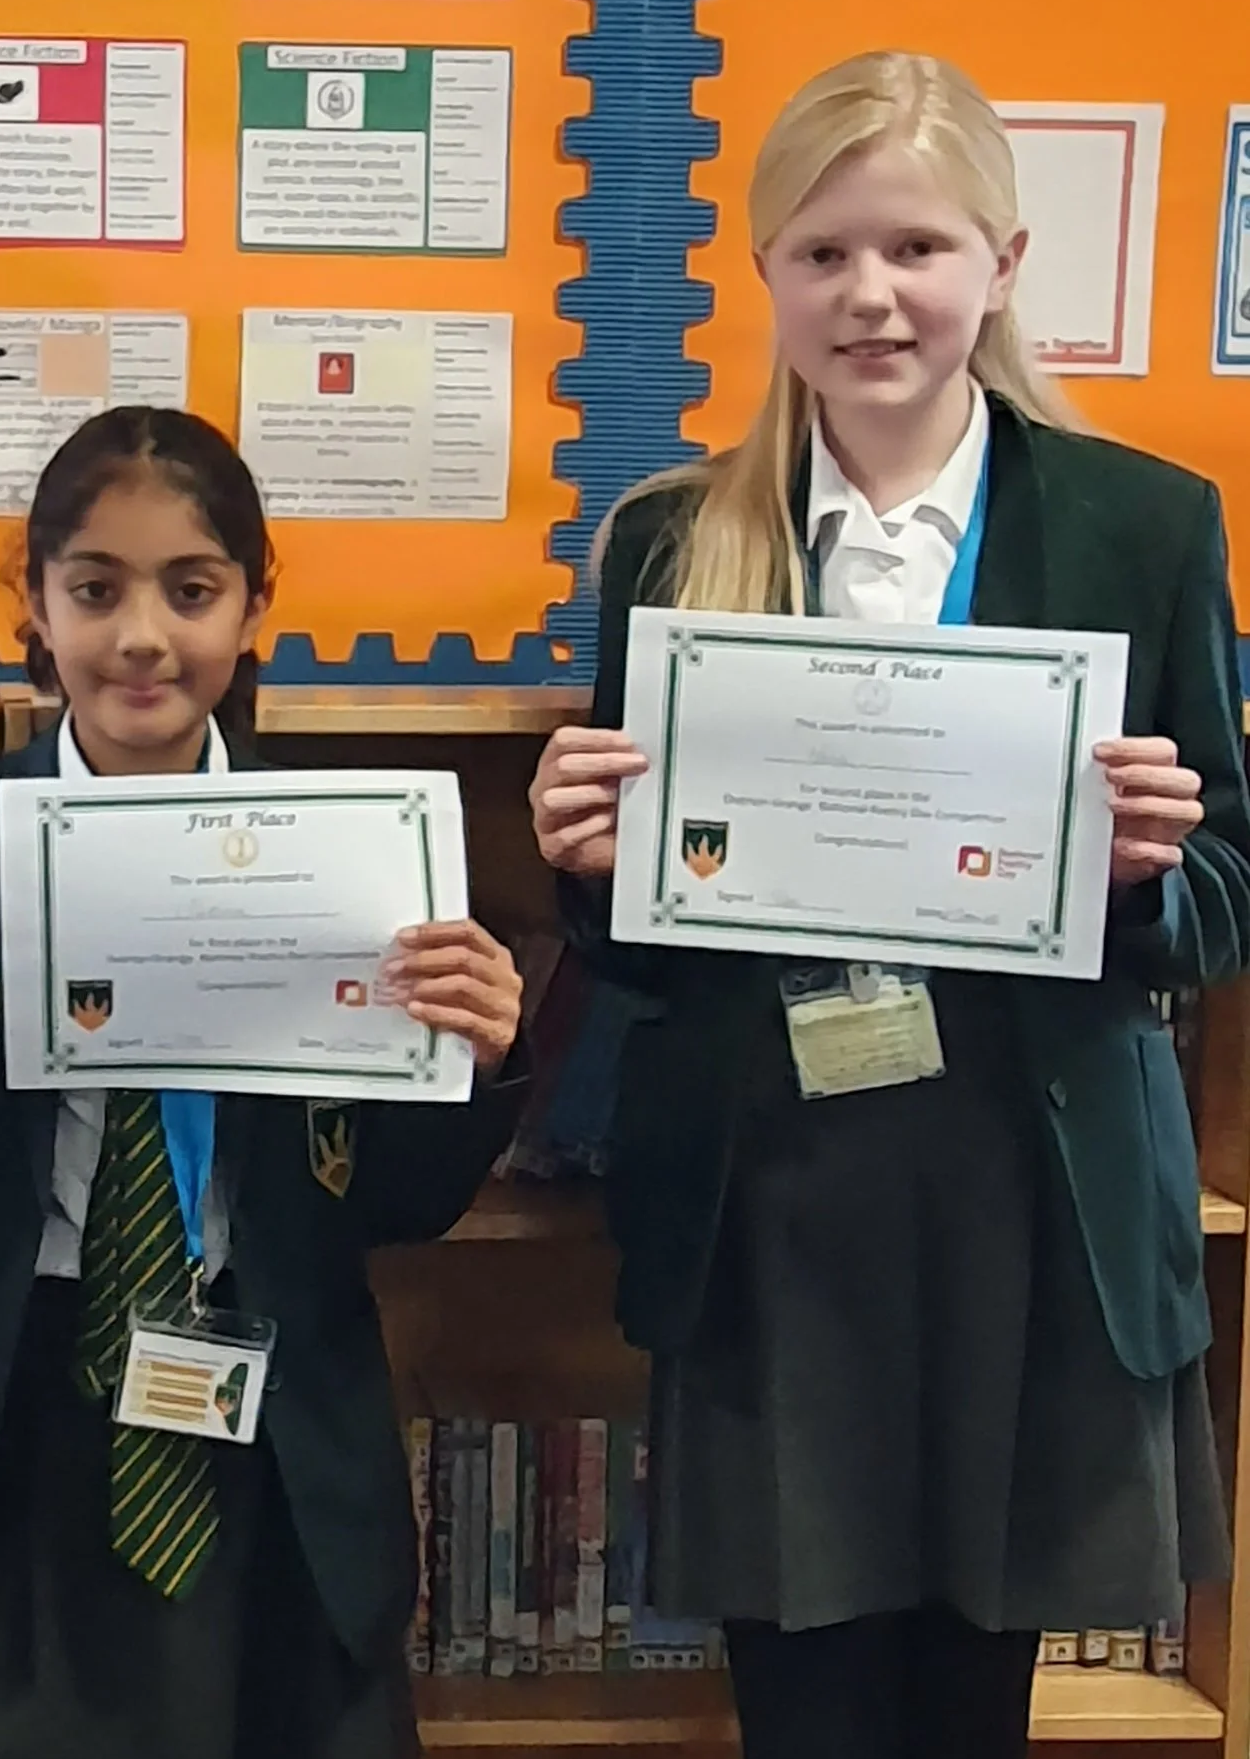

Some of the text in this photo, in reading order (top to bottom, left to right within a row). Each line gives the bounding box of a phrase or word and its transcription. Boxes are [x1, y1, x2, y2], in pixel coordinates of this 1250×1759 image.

[807, 657, 943, 680] Second Place
[184, 811, 296, 833] First Place
